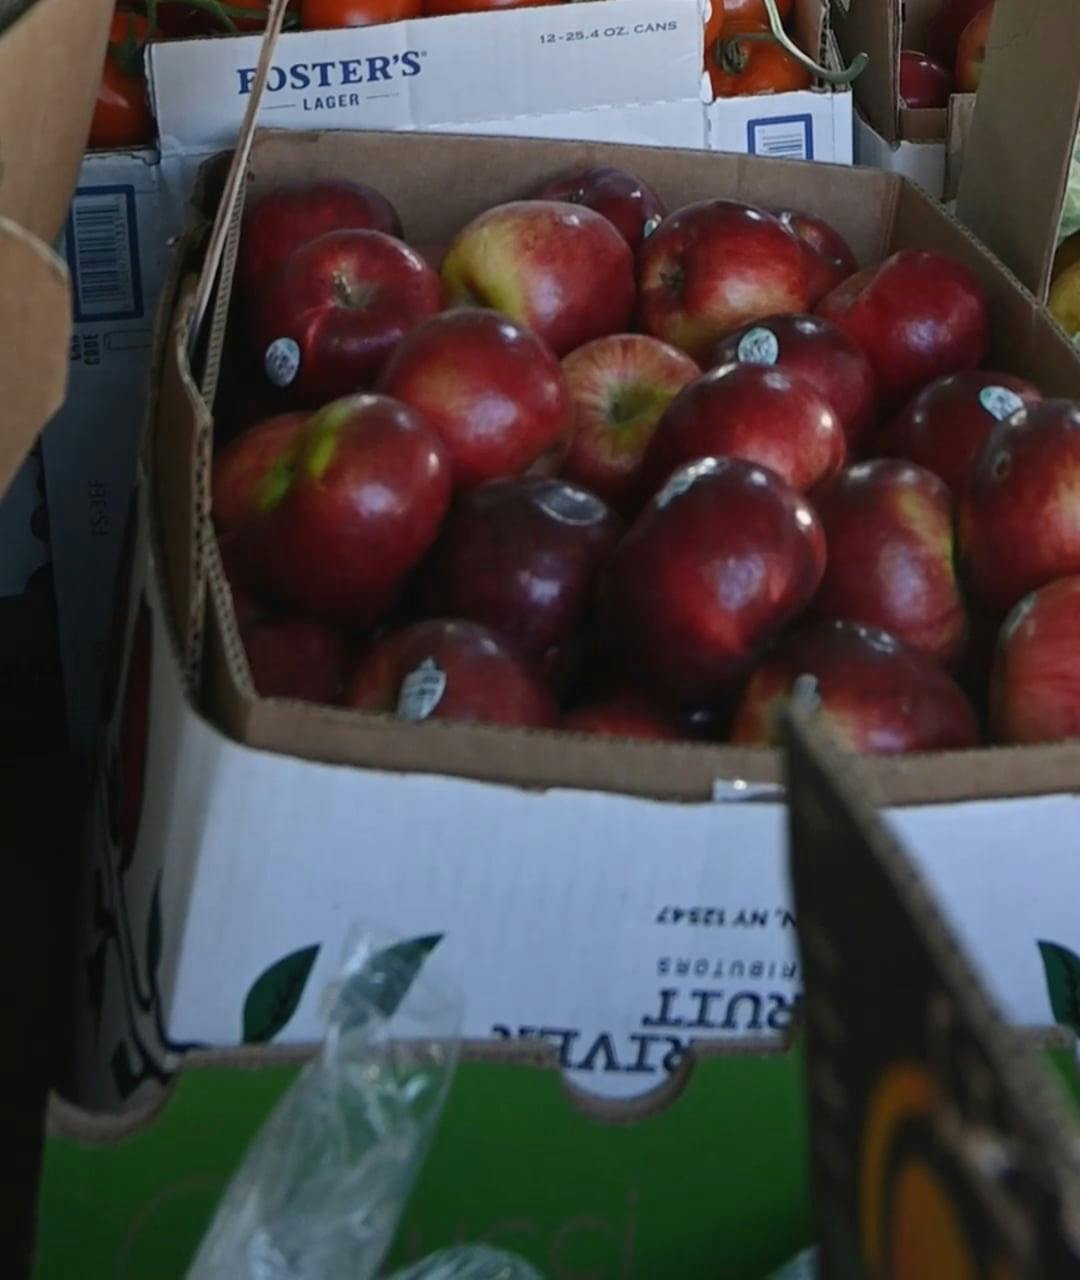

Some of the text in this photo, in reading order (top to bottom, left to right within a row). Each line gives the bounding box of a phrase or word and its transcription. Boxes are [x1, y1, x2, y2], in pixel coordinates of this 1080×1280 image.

[539, 20, 678, 44] 12-25.4 OZ. CANS
[302, 92, 361, 111] LAGER
[731, 908, 768, 927] NY
[656, 956, 798, 979] RIBUTORS
[641, 987, 801, 1030] RUIT
